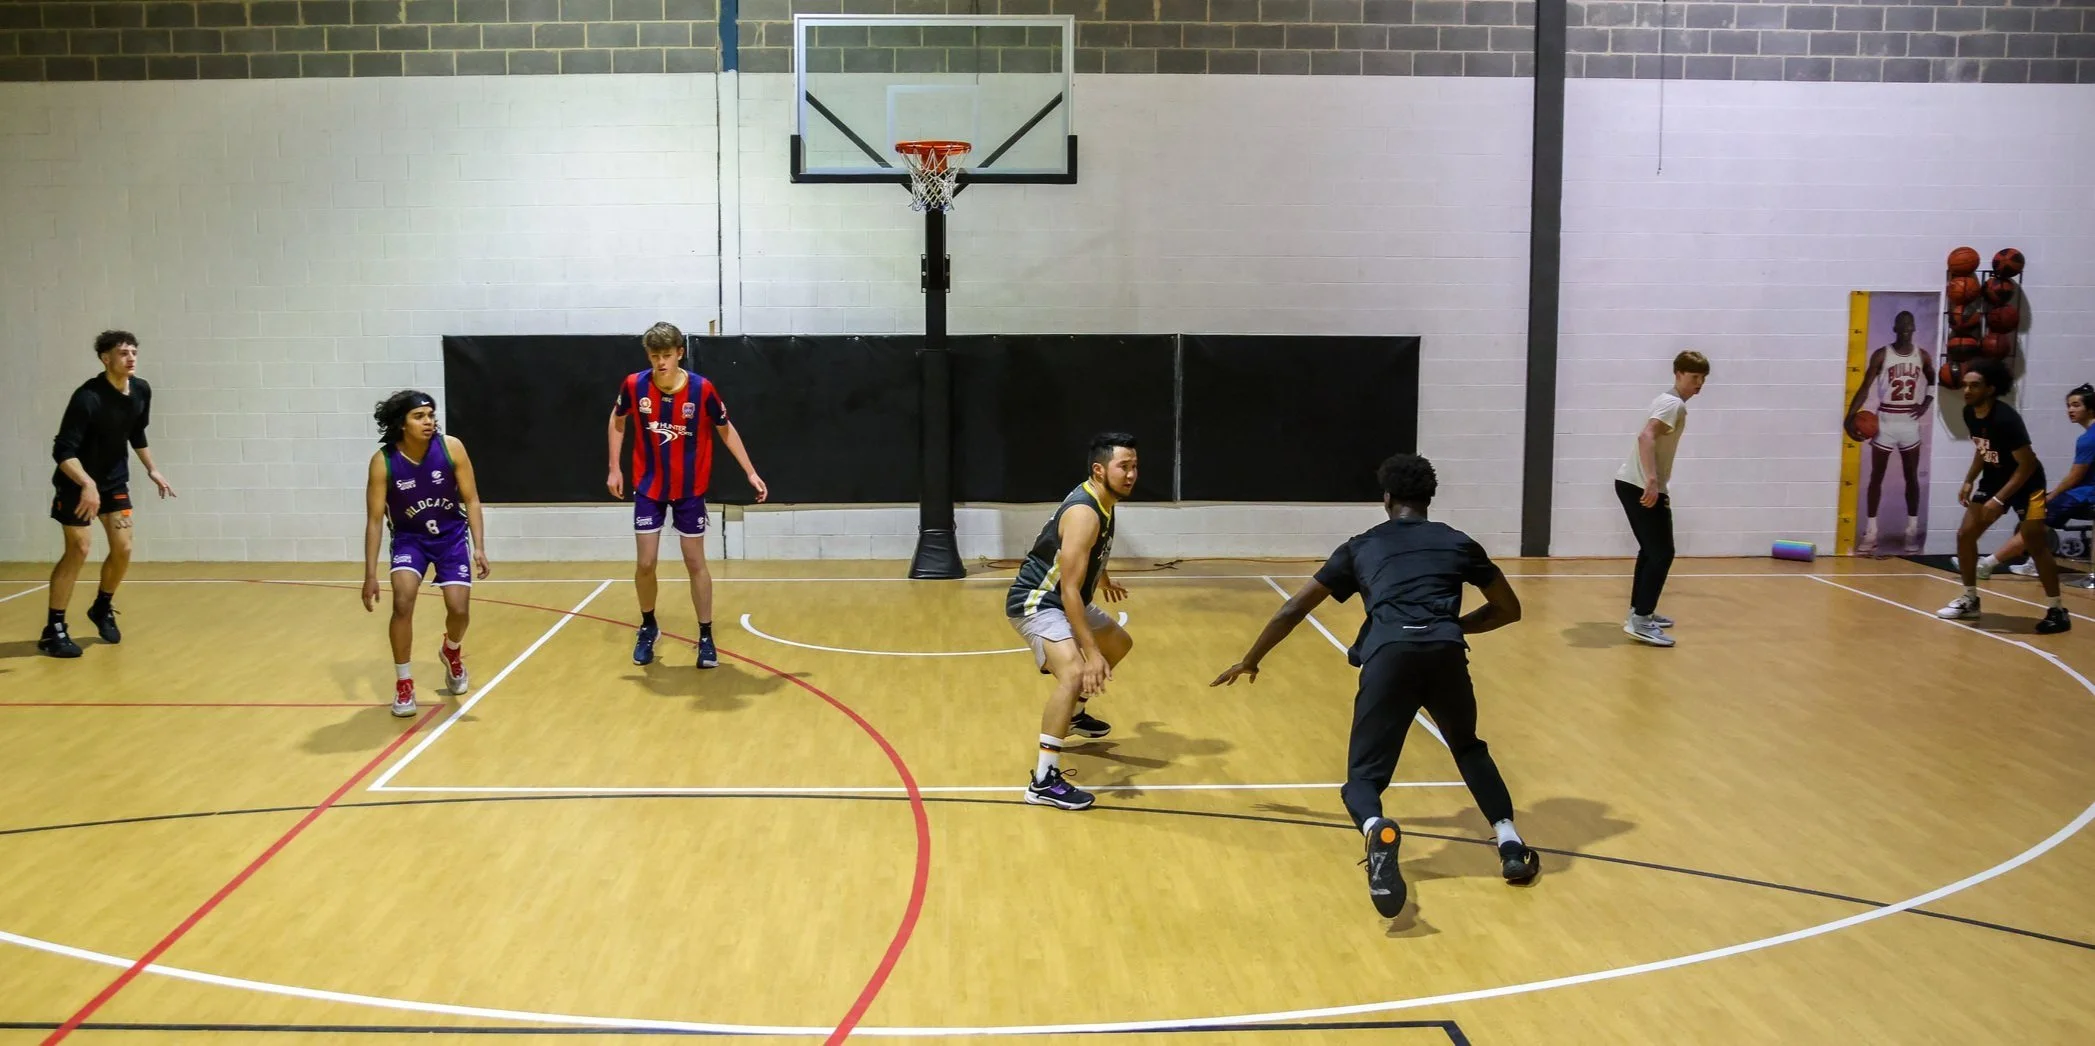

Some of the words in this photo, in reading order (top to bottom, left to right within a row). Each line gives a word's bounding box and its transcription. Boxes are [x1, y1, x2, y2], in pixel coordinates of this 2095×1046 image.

[1891, 379, 1916, 401] 23
[660, 422, 687, 431] HUNTER
[405, 497, 454, 518] WLDCATS
[425, 519, 440, 535] 8
